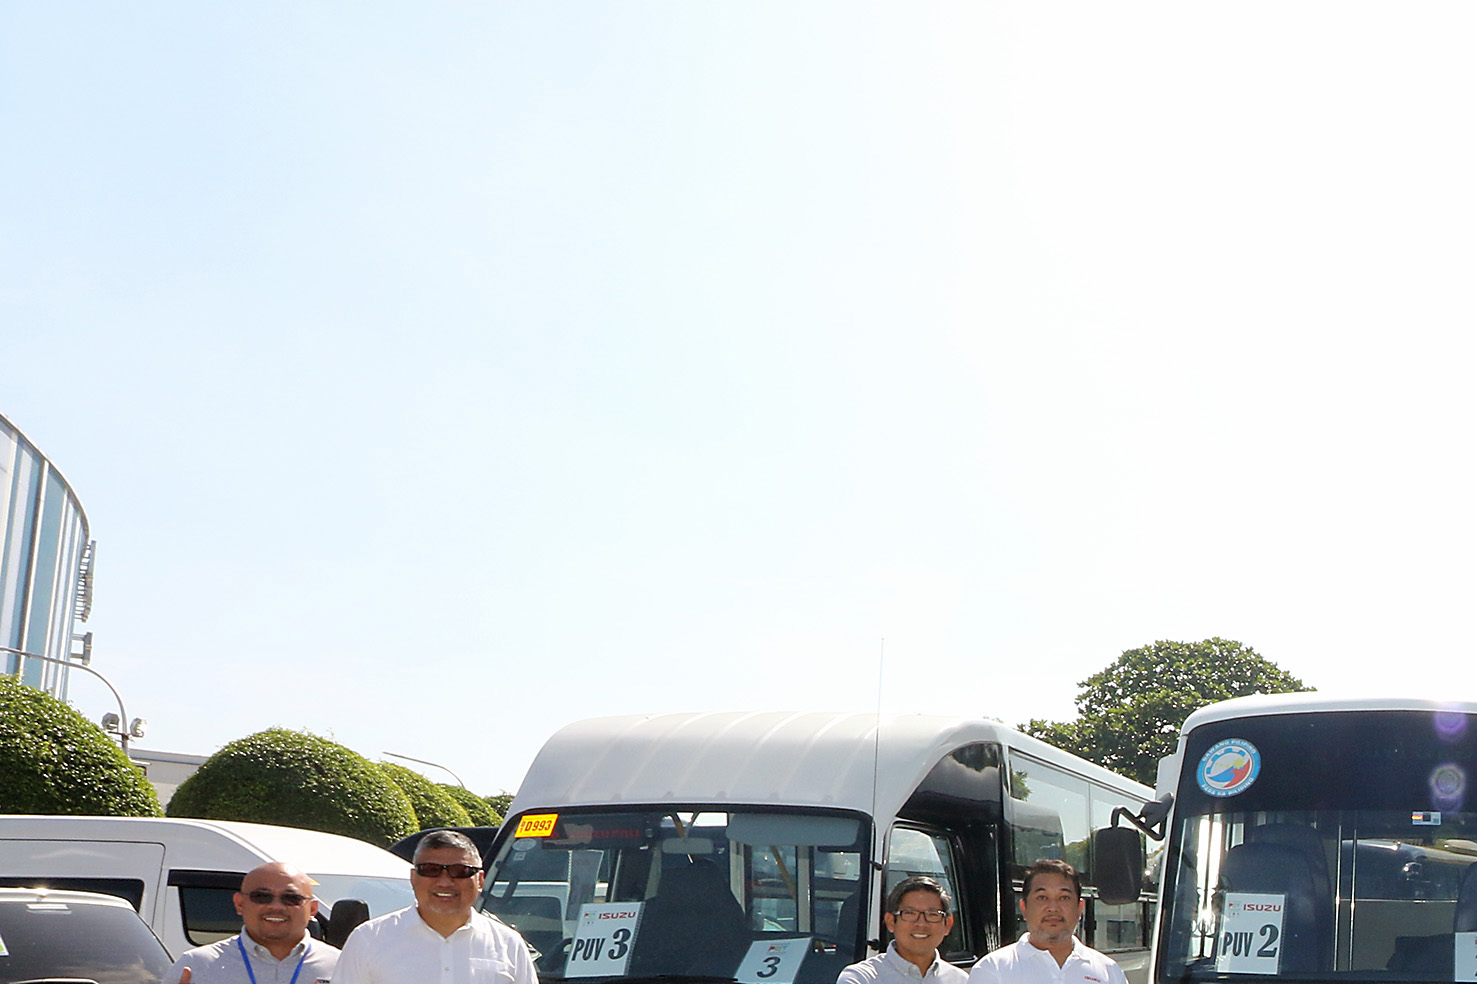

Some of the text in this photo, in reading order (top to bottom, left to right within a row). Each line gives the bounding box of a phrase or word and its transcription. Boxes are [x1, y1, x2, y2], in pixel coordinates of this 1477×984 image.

[524, 820, 553, 832] D993
[599, 911, 636, 919] ISUZU
[1243, 904, 1281, 912] ISUZU
[571, 928, 631, 961] PUV 3
[1222, 924, 1279, 957] PUV 2
[757, 956, 781, 978] 3
